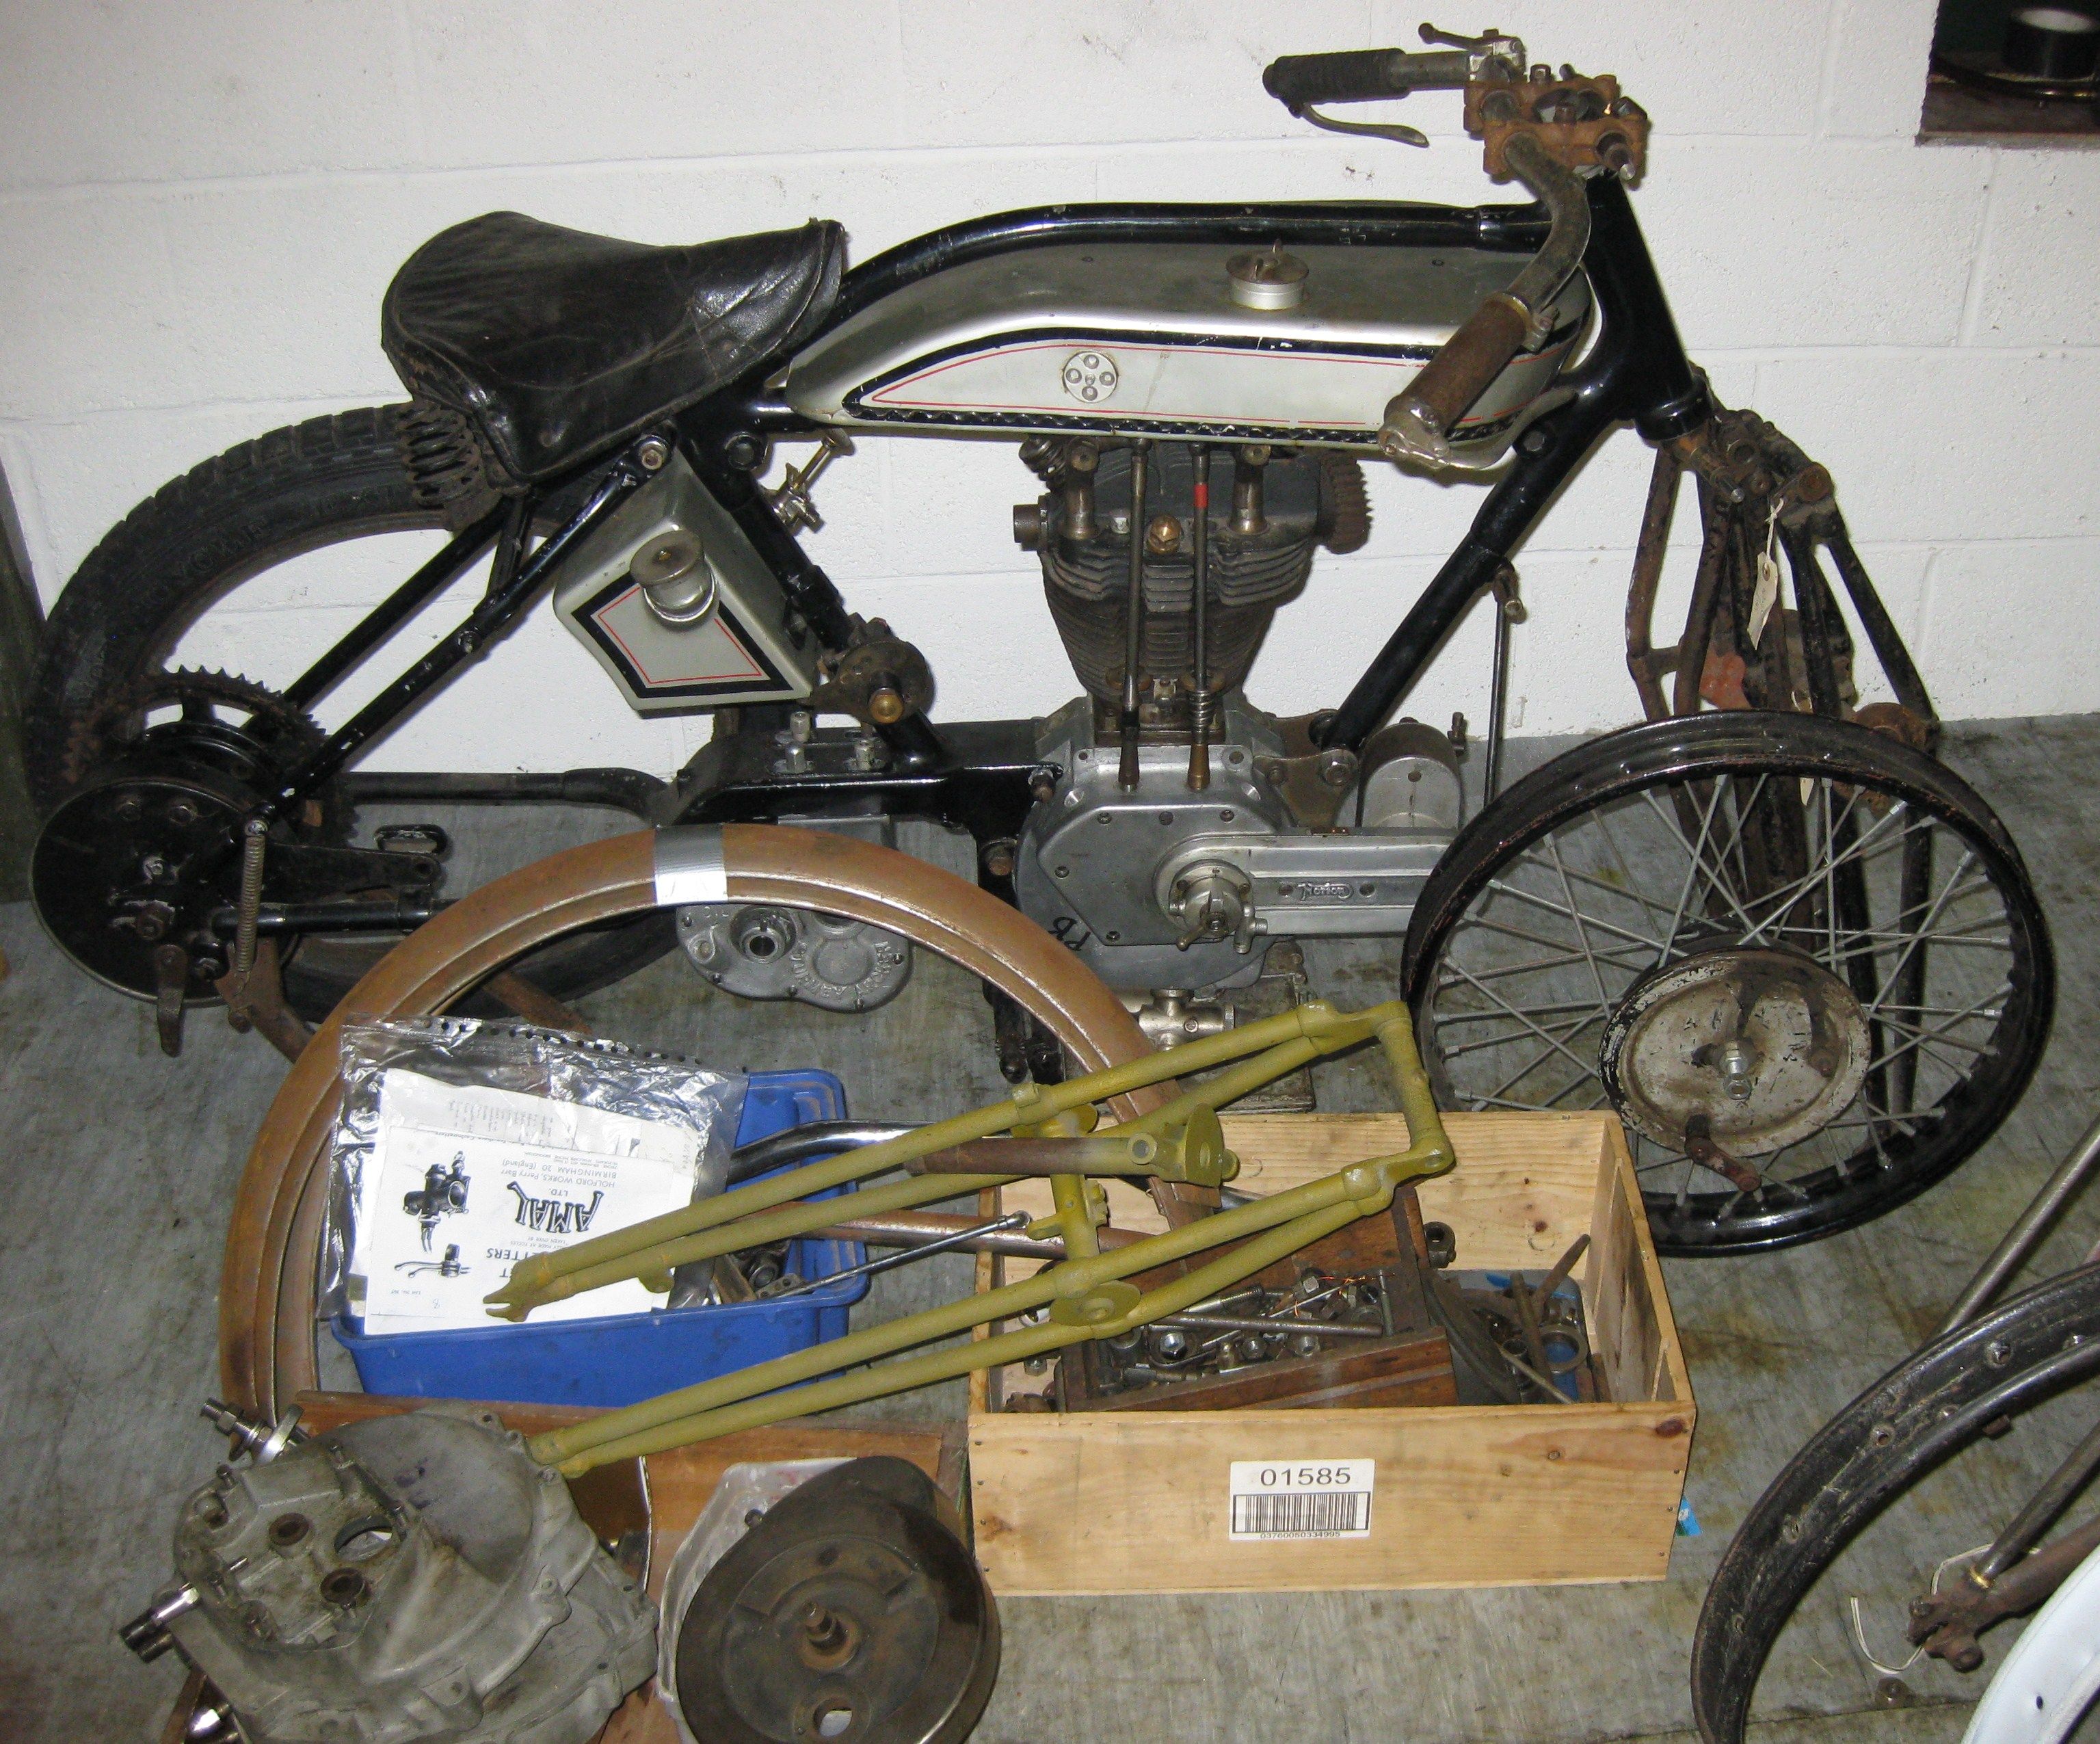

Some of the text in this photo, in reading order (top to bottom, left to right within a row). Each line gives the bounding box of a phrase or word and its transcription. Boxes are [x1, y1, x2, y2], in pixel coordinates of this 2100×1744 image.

[1297, 882, 1353, 901] Norton
[501, 1159, 536, 1170] (England)
[558, 1166, 617, 1178] BIRMINGHAM
[500, 1169, 615, 1188] HOLFORD WORKS, Perry Barr
[548, 1188, 568, 1197] LTD.
[506, 1181, 604, 1234] AMAL
[1260, 1467, 1351, 1486] 01585
[1260, 1531, 1341, 1539] 03760050334995
